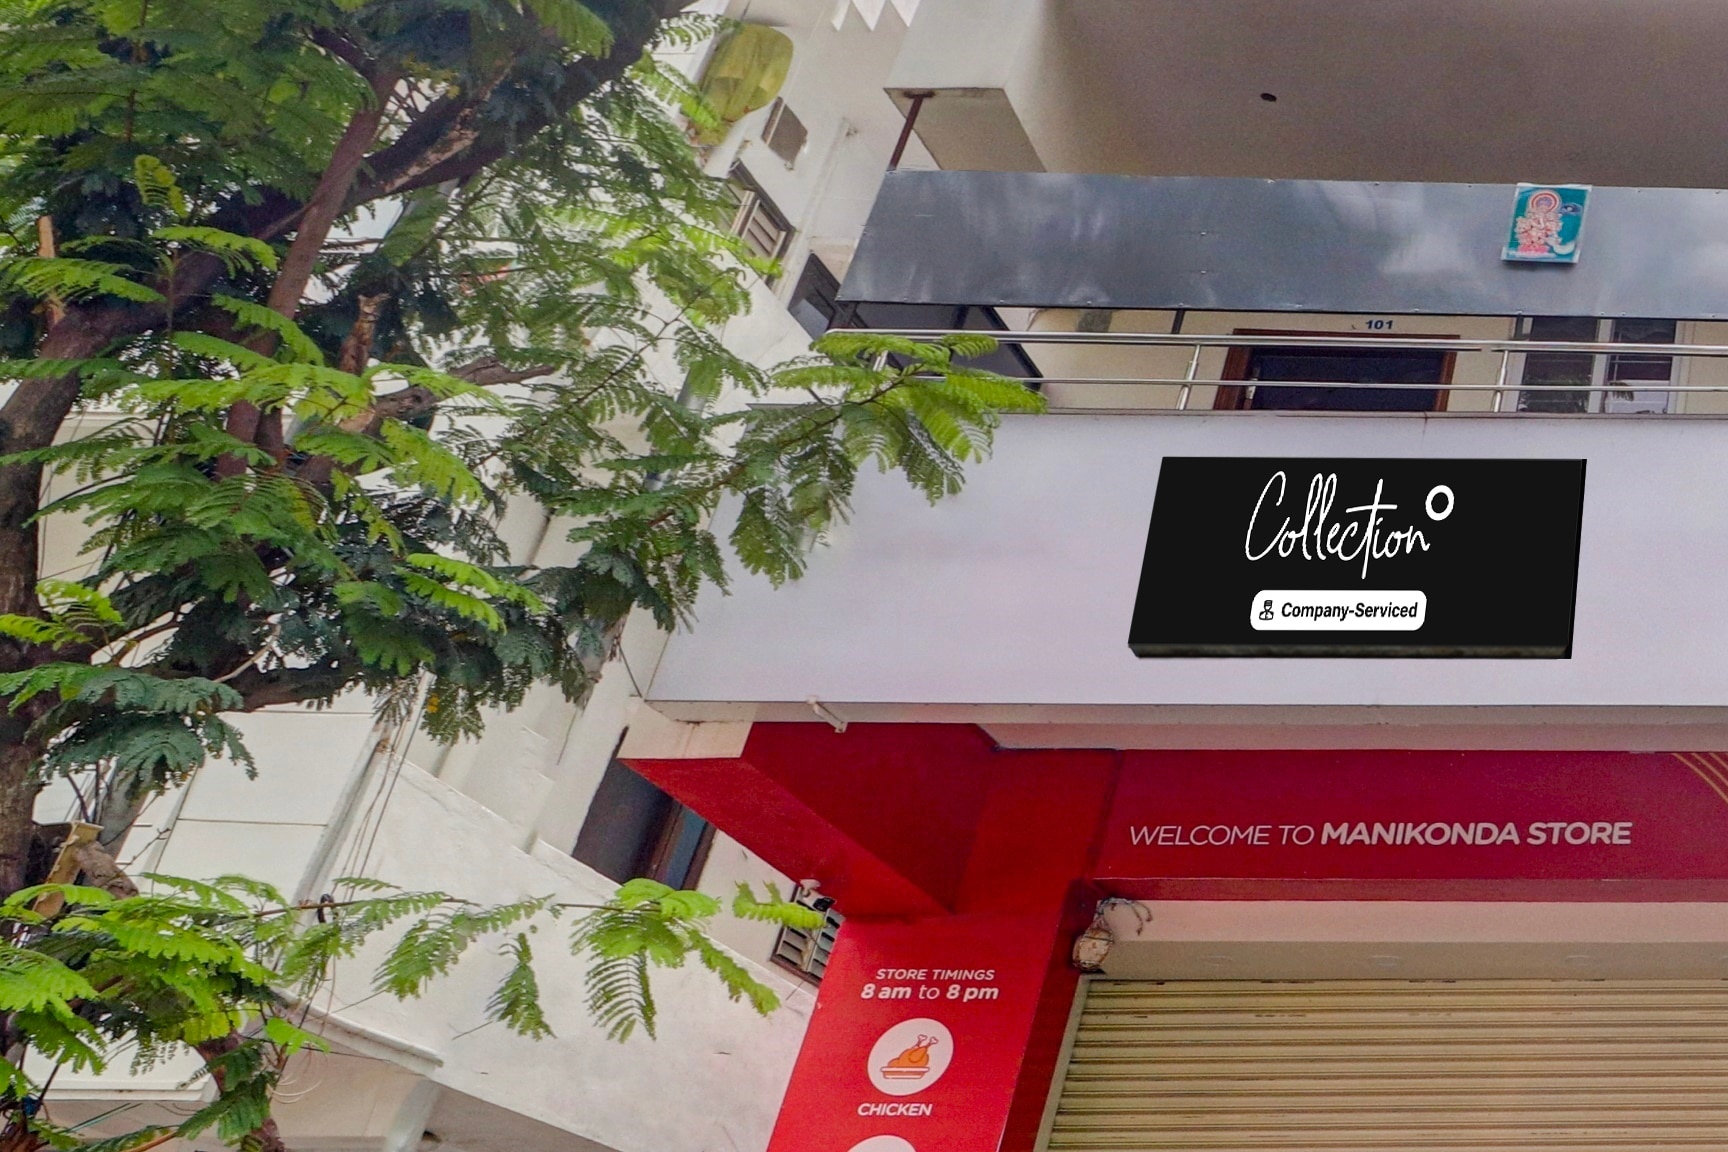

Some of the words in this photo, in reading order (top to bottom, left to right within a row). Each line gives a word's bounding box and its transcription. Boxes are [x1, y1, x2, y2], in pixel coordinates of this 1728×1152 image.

[1365, 319, 1394, 330] 101
[1244, 470, 1430, 579] Collection
[1280, 600, 1418, 622] Company-Serviced
[1129, 823, 1271, 846] WELCOME
[1278, 824, 1315, 846] TO
[1320, 822, 1520, 846] MANIKONDA
[1526, 821, 1633, 846] STORE
[876, 968, 928, 981] STORE
[932, 968, 995, 981] TIMINGS
[860, 983, 876, 1000] 8
[878, 986, 912, 1000] am
[918, 984, 941, 1000] to
[946, 984, 960, 1000] 8
[962, 986, 999, 1003] pm
[857, 1102, 933, 1117] CHICKEN
